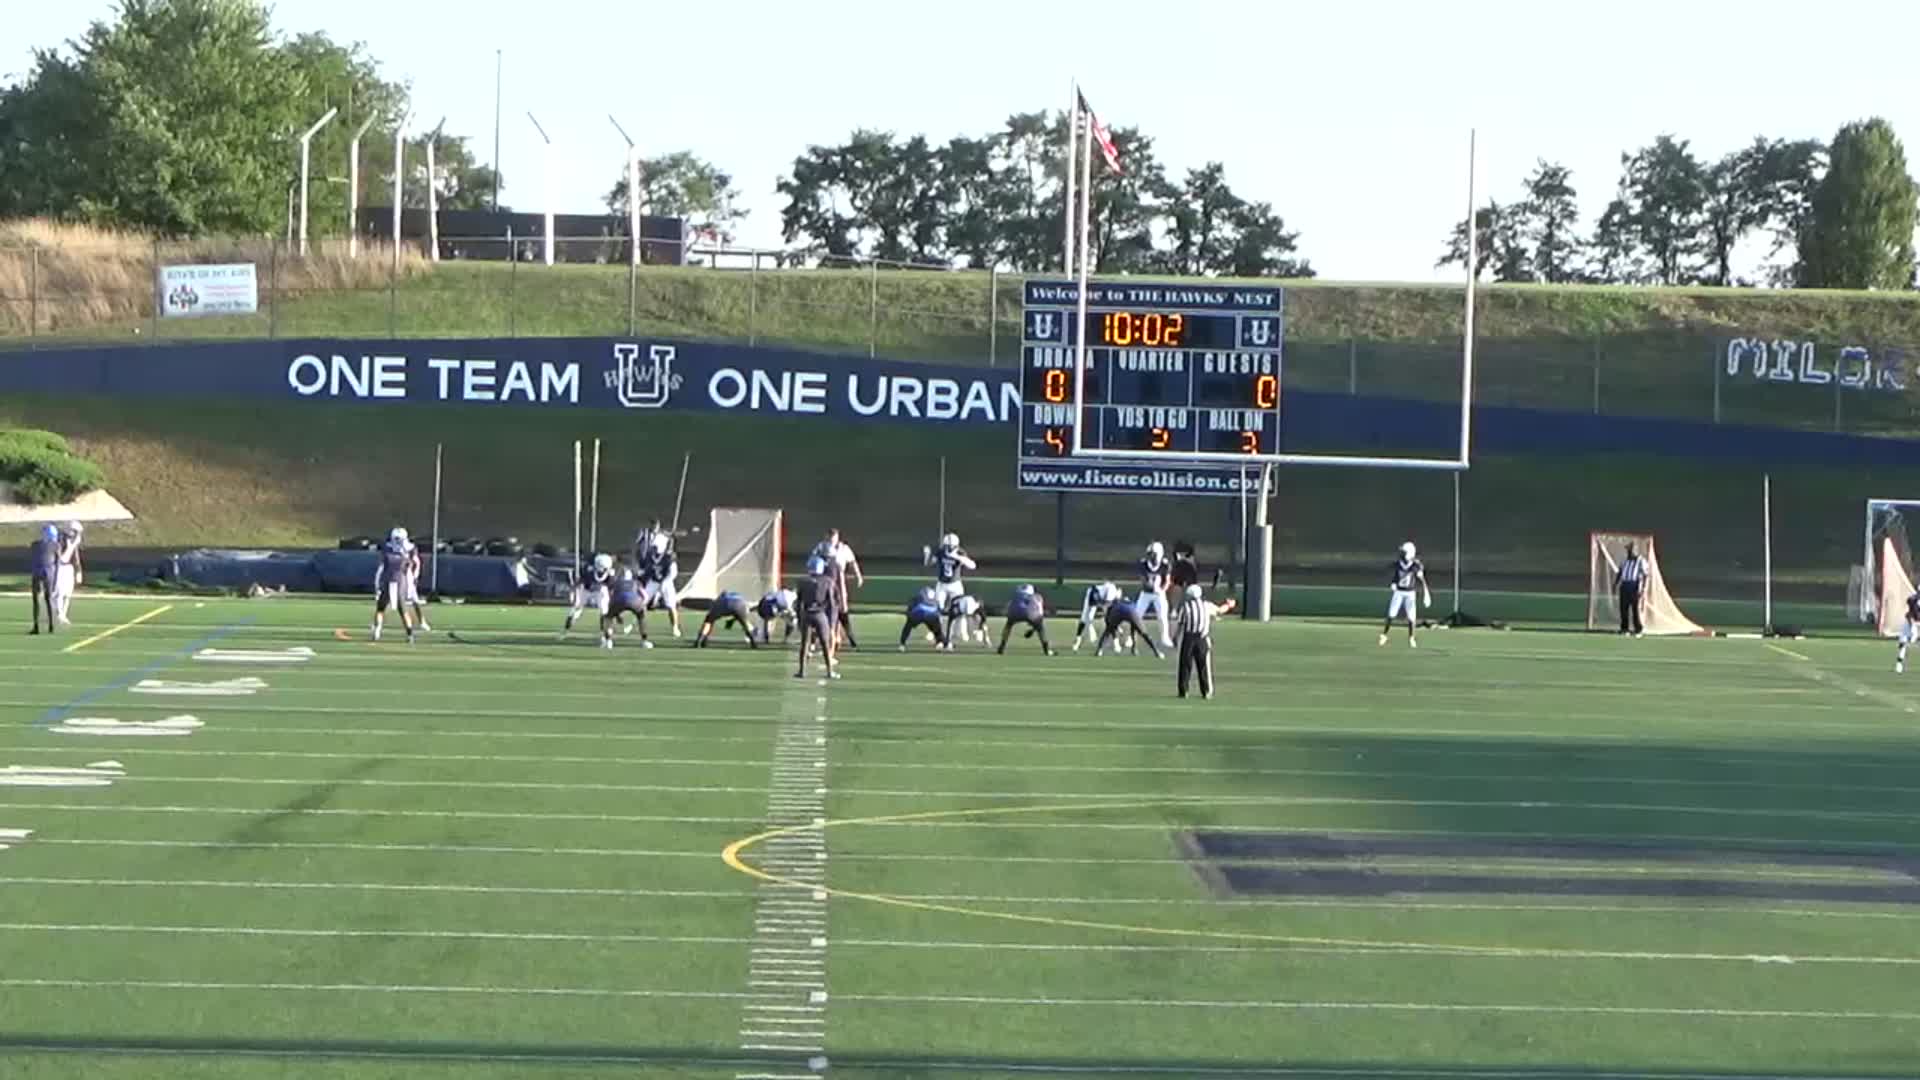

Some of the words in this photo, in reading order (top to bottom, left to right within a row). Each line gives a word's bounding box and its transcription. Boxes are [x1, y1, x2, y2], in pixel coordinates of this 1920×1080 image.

[1107, 289, 1124, 301] to
[1128, 289, 1162, 302] THE
[1165, 290, 1228, 305] HAWKS'
[1234, 291, 1273, 306] NEST
[1104, 311, 1183, 347] 10:02
[1033, 347, 1095, 369] URBAA
[1118, 351, 1184, 372] QUARTER
[1203, 353, 1272, 375] GUESTS
[288, 355, 406, 397] ONE
[428, 358, 580, 403] TEAM
[1045, 369, 1065, 402] 0
[708, 367, 827, 414] ONE
[1257, 375, 1276, 408] 0
[1034, 404, 1075, 425] DOWN
[1148, 408, 1165, 429] TO
[1168, 409, 1188, 430] GO
[1209, 410, 1240, 431] BALL
[1244, 411, 1264, 432] ON
[1046, 428, 1065, 456] 4
